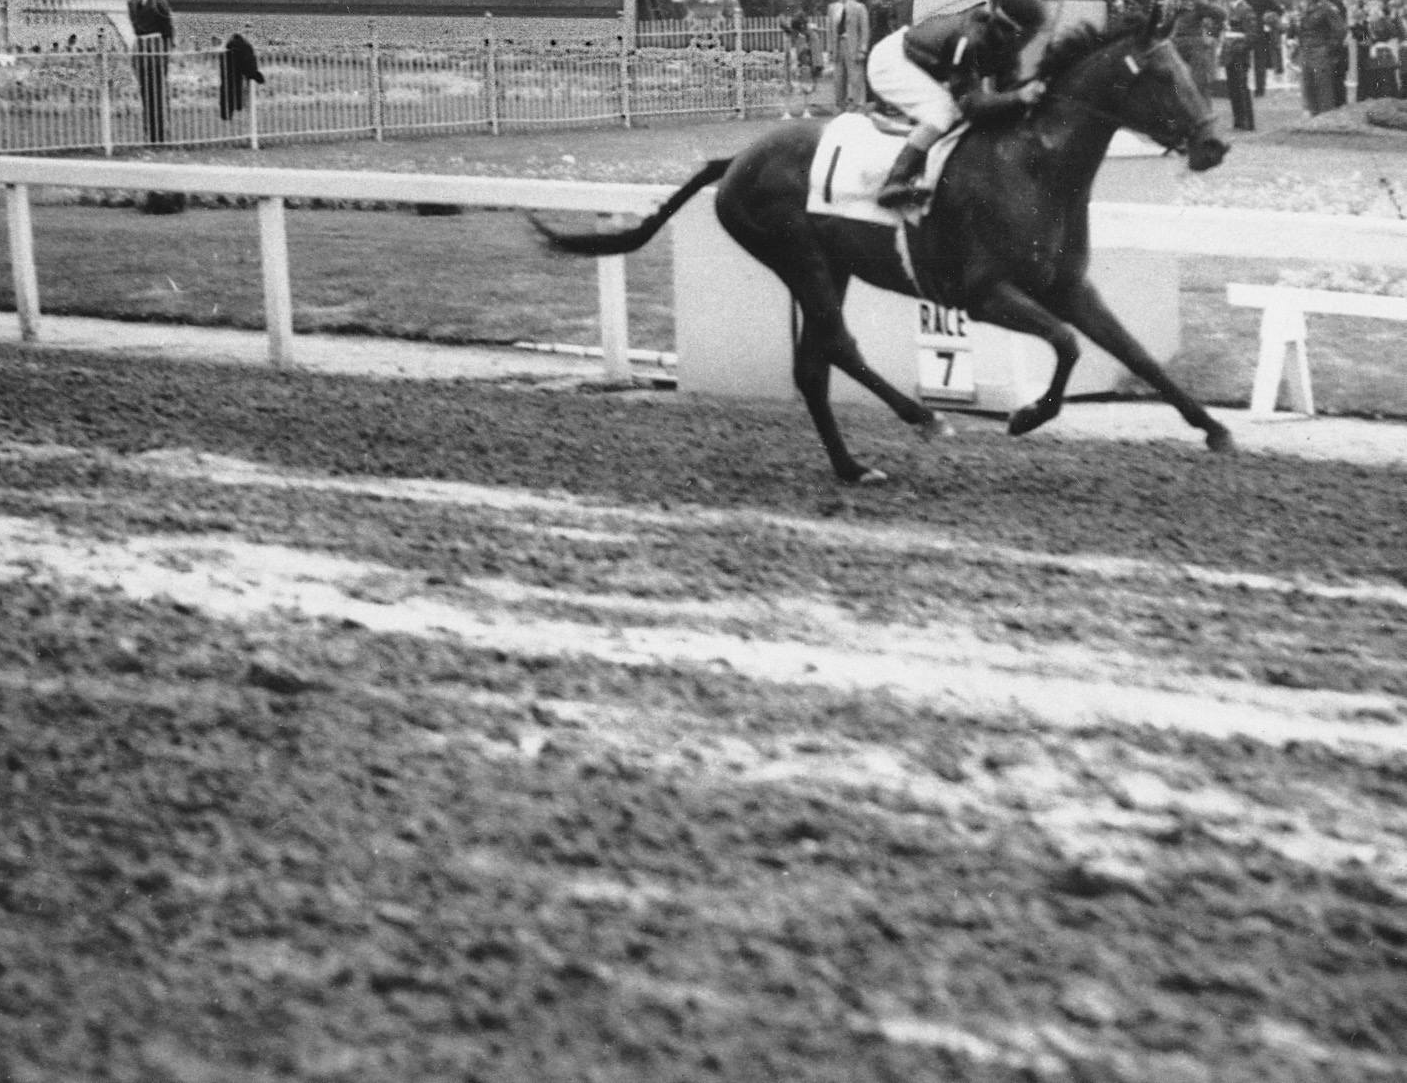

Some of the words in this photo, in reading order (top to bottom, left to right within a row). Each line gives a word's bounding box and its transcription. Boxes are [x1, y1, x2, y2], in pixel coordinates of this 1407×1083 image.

[824, 145, 842, 204] 1
[920, 304, 967, 337] RACE
[936, 351, 955, 387] 7
